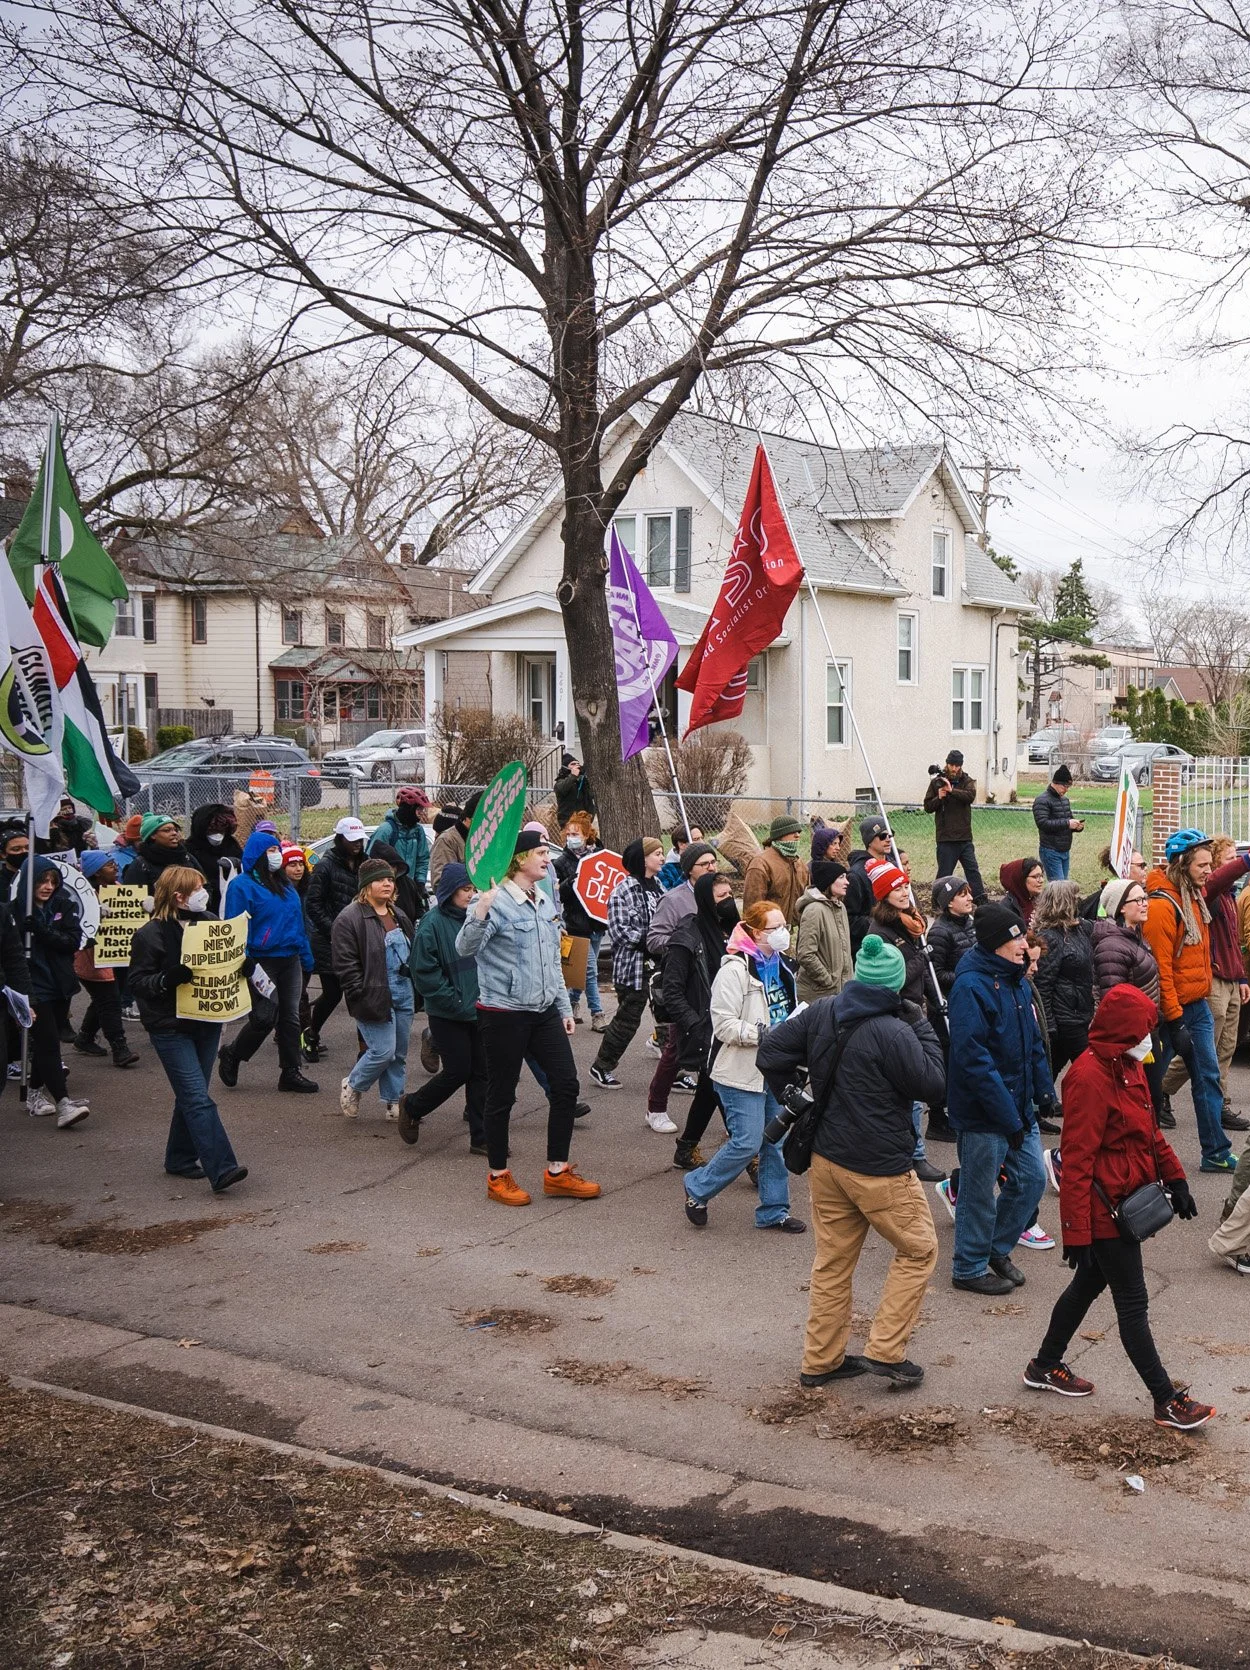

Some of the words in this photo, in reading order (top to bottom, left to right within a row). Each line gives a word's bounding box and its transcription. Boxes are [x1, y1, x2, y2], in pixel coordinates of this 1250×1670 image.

[716, 599, 753, 643] Socialist
[484, 778, 502, 813] NO
[590, 861, 627, 887] STO
[74, 877, 94, 896] OF
[117, 888, 133, 897] No
[98, 926, 138, 936] Witho
[208, 923, 232, 937] NO
[104, 936, 132, 947] Raci
[203, 935, 236, 951] NEW
[98, 947, 131, 958] Justic
[191, 981, 240, 1000] JUSTICE
[198, 996, 240, 1012] NOW!
